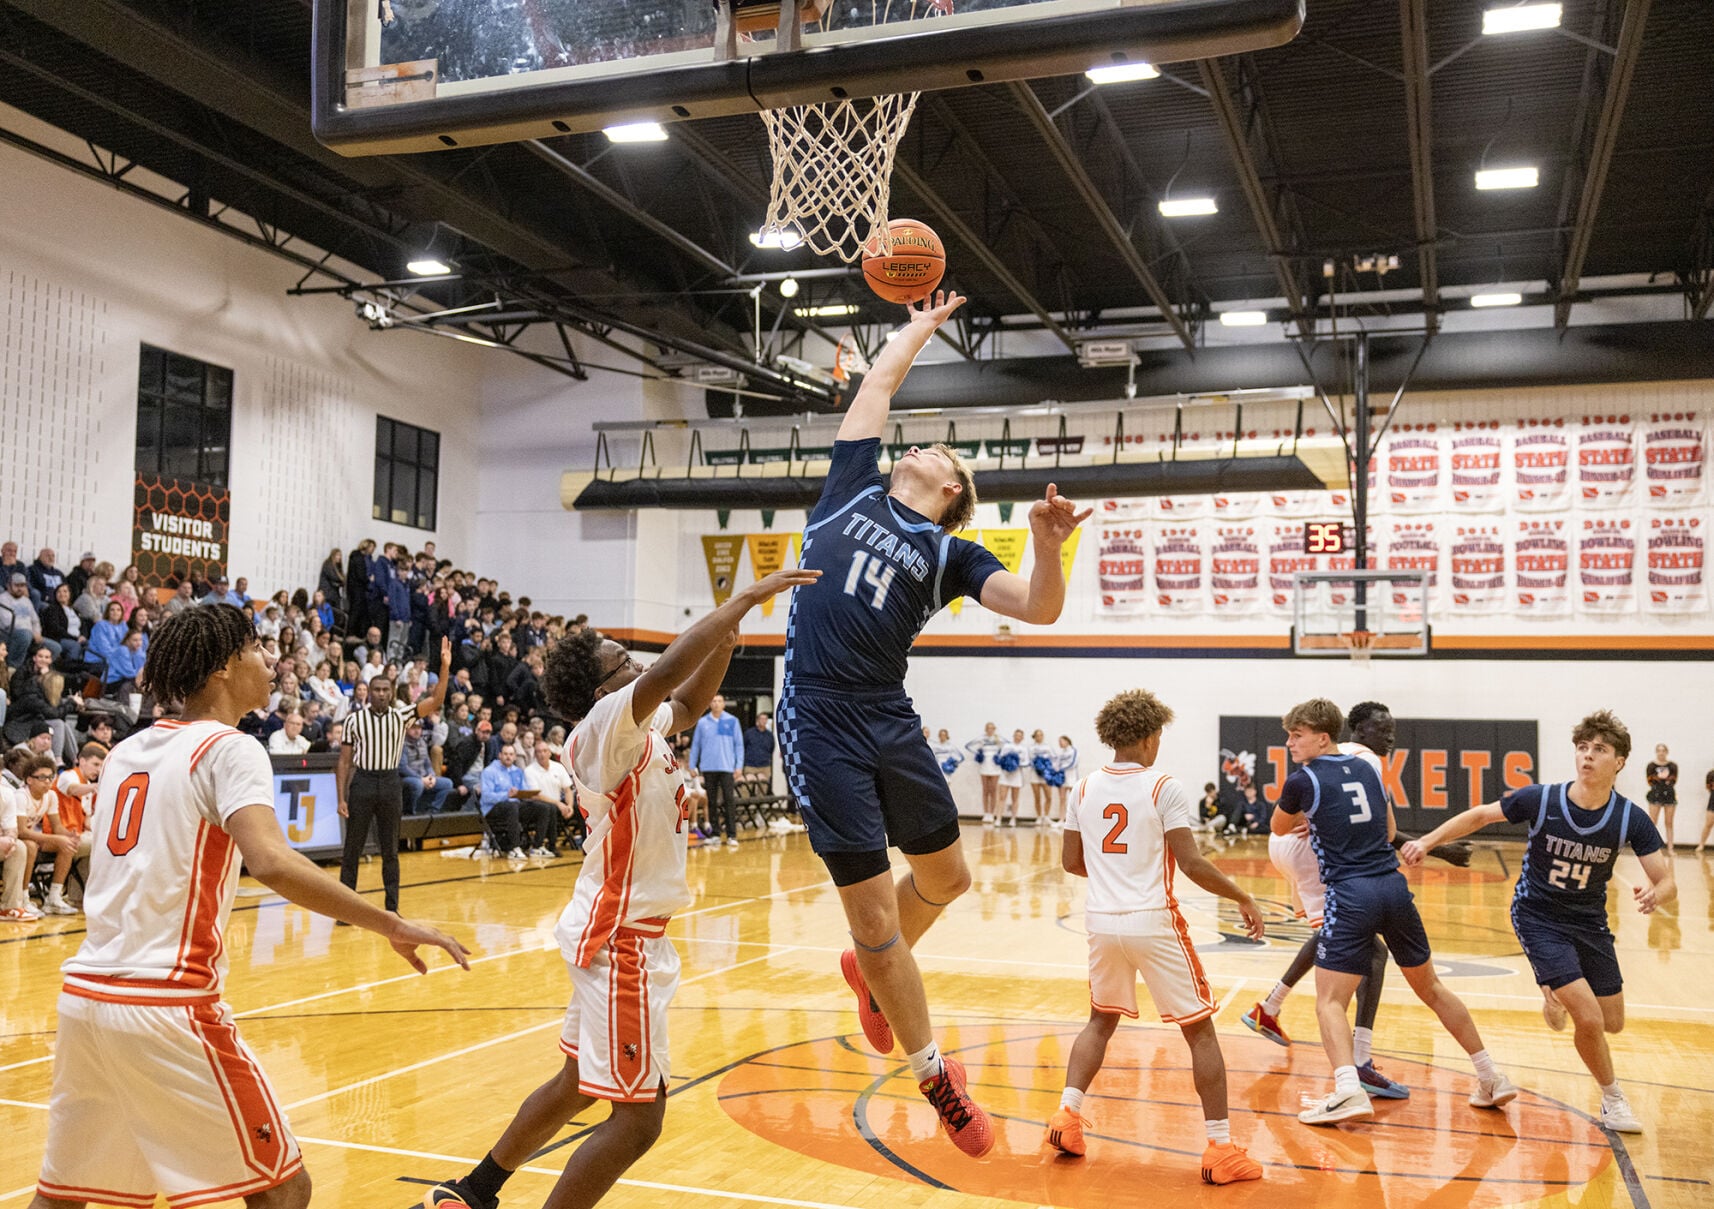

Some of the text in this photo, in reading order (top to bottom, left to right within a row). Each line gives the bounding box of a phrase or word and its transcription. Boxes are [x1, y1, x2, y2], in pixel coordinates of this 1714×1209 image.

[884, 236, 936, 252] PALDING
[882, 262, 931, 272] LEGACY
[1452, 452, 1500, 470] STATE
[1515, 451, 1568, 468] STATE
[1579, 448, 1632, 465] STATE
[1646, 445, 1702, 464] STATE
[1389, 455, 1438, 472] STATE
[152, 512, 213, 539] VISITOR
[141, 532, 221, 560] STUDENTS
[1309, 524, 1341, 552] 35
[1515, 538, 1567, 552] BOWLING
[1580, 537, 1634, 550] BOWLING
[1648, 535, 1703, 549] BOWLING
[842, 512, 930, 582] TITANS
[1451, 542, 1504, 555] BOWLING
[1100, 559, 1144, 575] STATE
[1155, 558, 1201, 575] STATE
[1212, 558, 1259, 574] STATE
[1270, 557, 1316, 573] STATE
[1388, 555, 1438, 571] STATE
[1452, 557, 1504, 574] STATE
[1516, 554, 1568, 571] STATE
[1580, 552, 1633, 569] STATE
[1648, 551, 1703, 569] STATE
[843, 550, 897, 611] 14
[280, 779, 316, 843] TJ
[1342, 781, 1372, 824] 3
[107, 771, 150, 856] 0
[1102, 803, 1128, 854] 2
[1545, 834, 1612, 863] TITANS
[1548, 858, 1592, 890] 24
